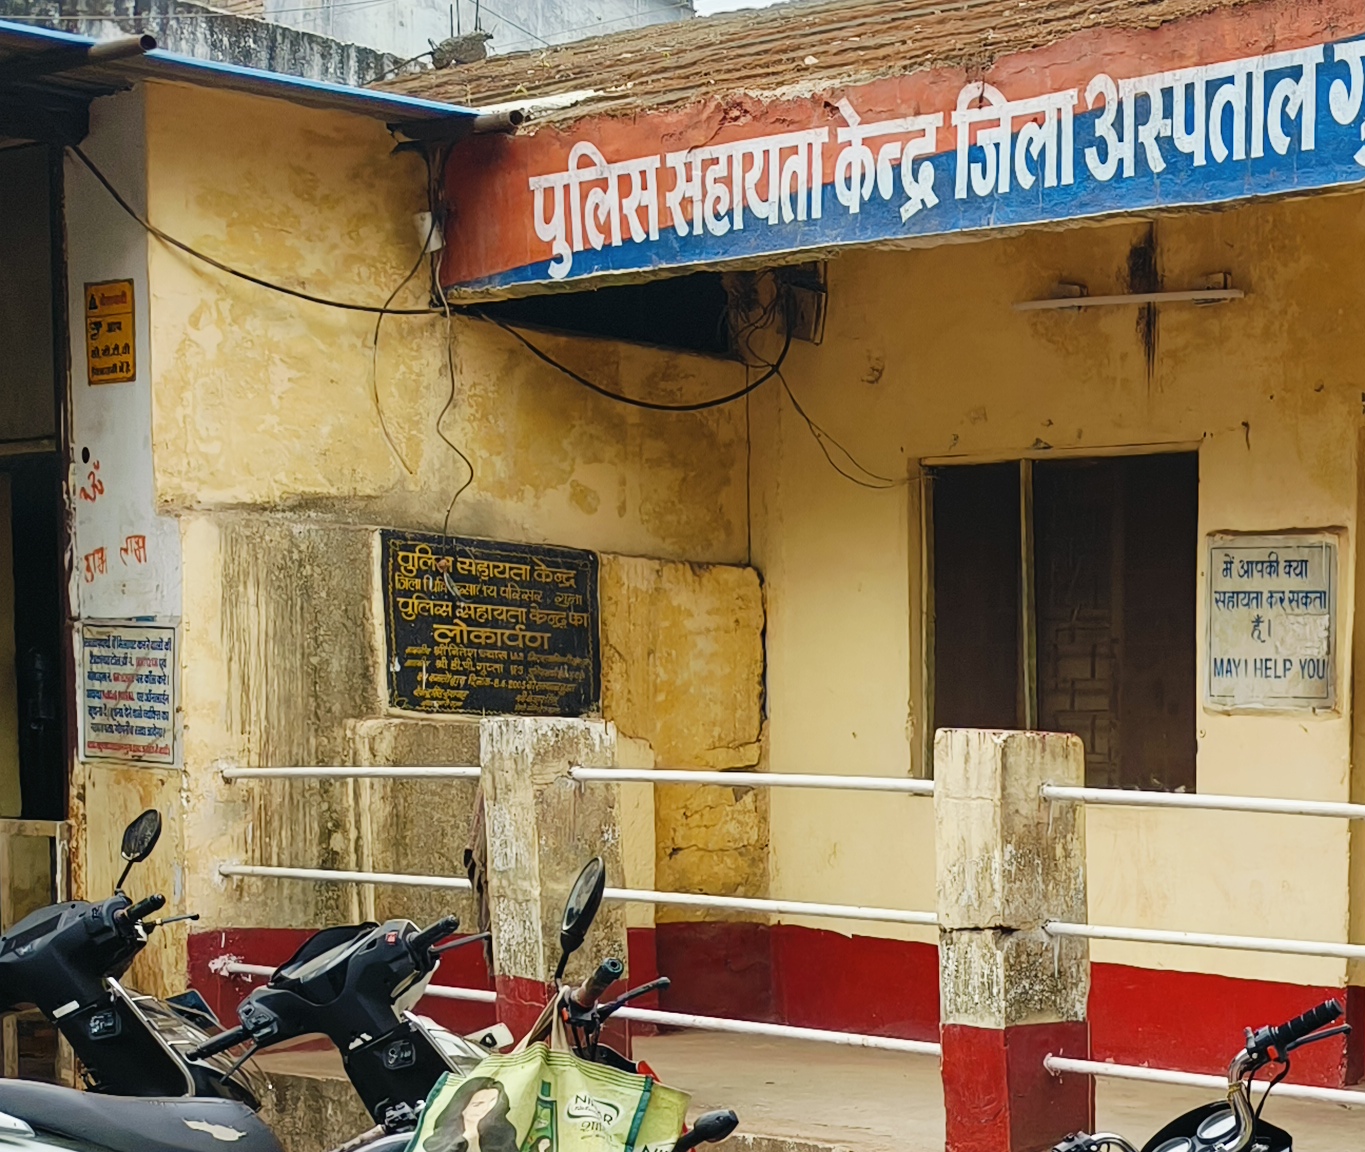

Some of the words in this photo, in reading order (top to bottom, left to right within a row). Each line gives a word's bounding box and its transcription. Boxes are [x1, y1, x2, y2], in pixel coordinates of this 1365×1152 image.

[529, 140, 661, 280] पुलिस
[666, 126, 829, 237] सहायता
[835, 97, 944, 222] केन्द्र
[951, 81, 1079, 200] जिला
[1083, 44, 1324, 181] अस्पताल
[456, 557, 531, 581] सहायता
[1238, 551, 1279, 580] आपकी
[1283, 559, 1309, 579] क्या
[396, 593, 452, 620] पुलिस
[456, 602, 527, 625] सहायता
[1214, 591, 1263, 613] सहायता
[1266, 591, 1286, 612] कर
[1288, 590, 1327, 610] सकता
[433, 618, 551, 650] लोकार्पण
[1213, 657, 1241, 678] MAY
[1244, 659, 1248, 678] I
[1254, 657, 1293, 679] HELP
[1299, 657, 1326, 680] YOU
